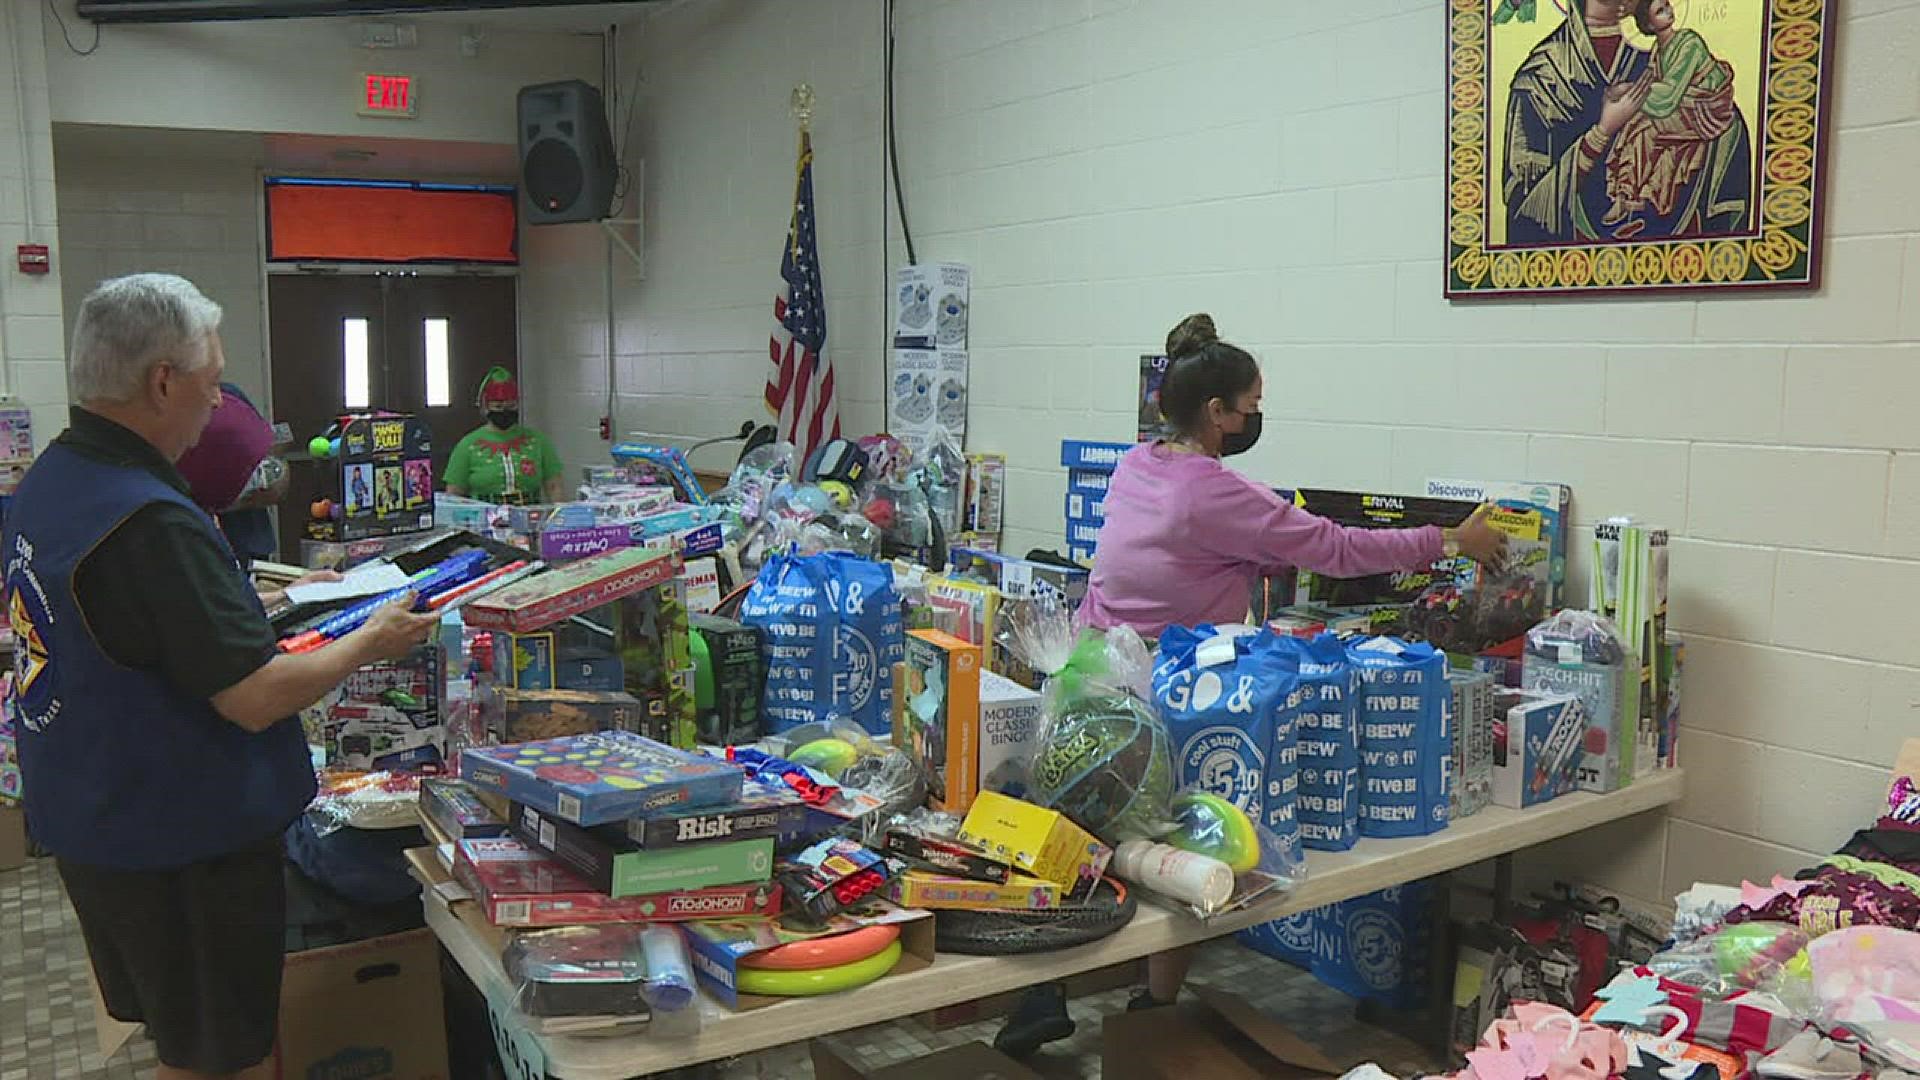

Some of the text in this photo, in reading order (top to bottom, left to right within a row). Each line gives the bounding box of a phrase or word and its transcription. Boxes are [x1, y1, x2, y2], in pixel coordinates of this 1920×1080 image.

[366, 75, 410, 109] EXIT
[1428, 481, 1484, 499] Discovery
[1372, 496, 1405, 510] RIVAL
[603, 565, 662, 596] MONOPOLY
[984, 704, 1040, 721] MODERN
[1366, 696, 1397, 711] five
[1189, 735, 1241, 767] cool stuff
[1368, 778, 1403, 793] five
[676, 814, 733, 841] Risk
[669, 893, 746, 912] MONOPOLY
